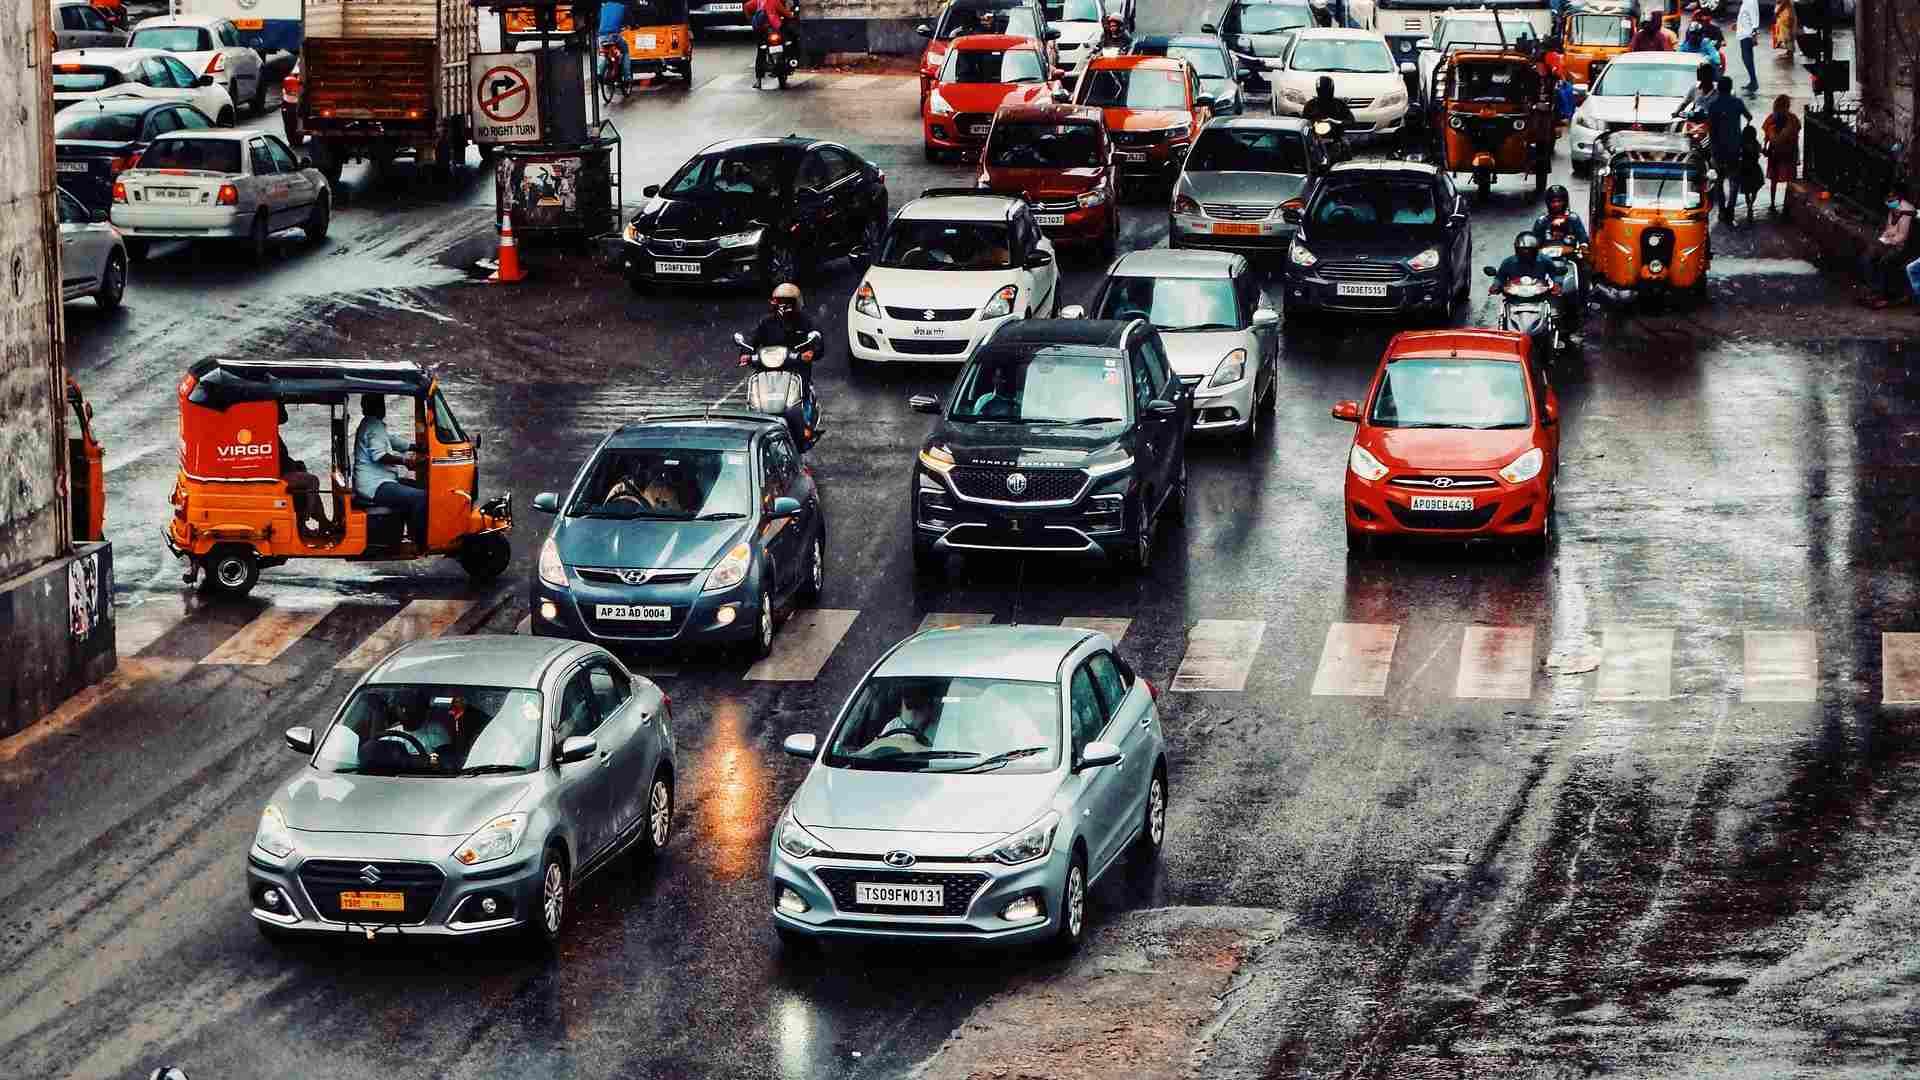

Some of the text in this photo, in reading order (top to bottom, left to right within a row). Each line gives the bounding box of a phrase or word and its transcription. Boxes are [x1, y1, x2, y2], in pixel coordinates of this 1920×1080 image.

[478, 124, 536, 137] NO RIGHT TURN
[216, 444, 272, 456] VIRGO
[601, 607, 614, 617] AP
[615, 607, 626, 617] 23
[643, 608, 665, 618] 0004
[864, 887, 941, 903] TS09FN0131
